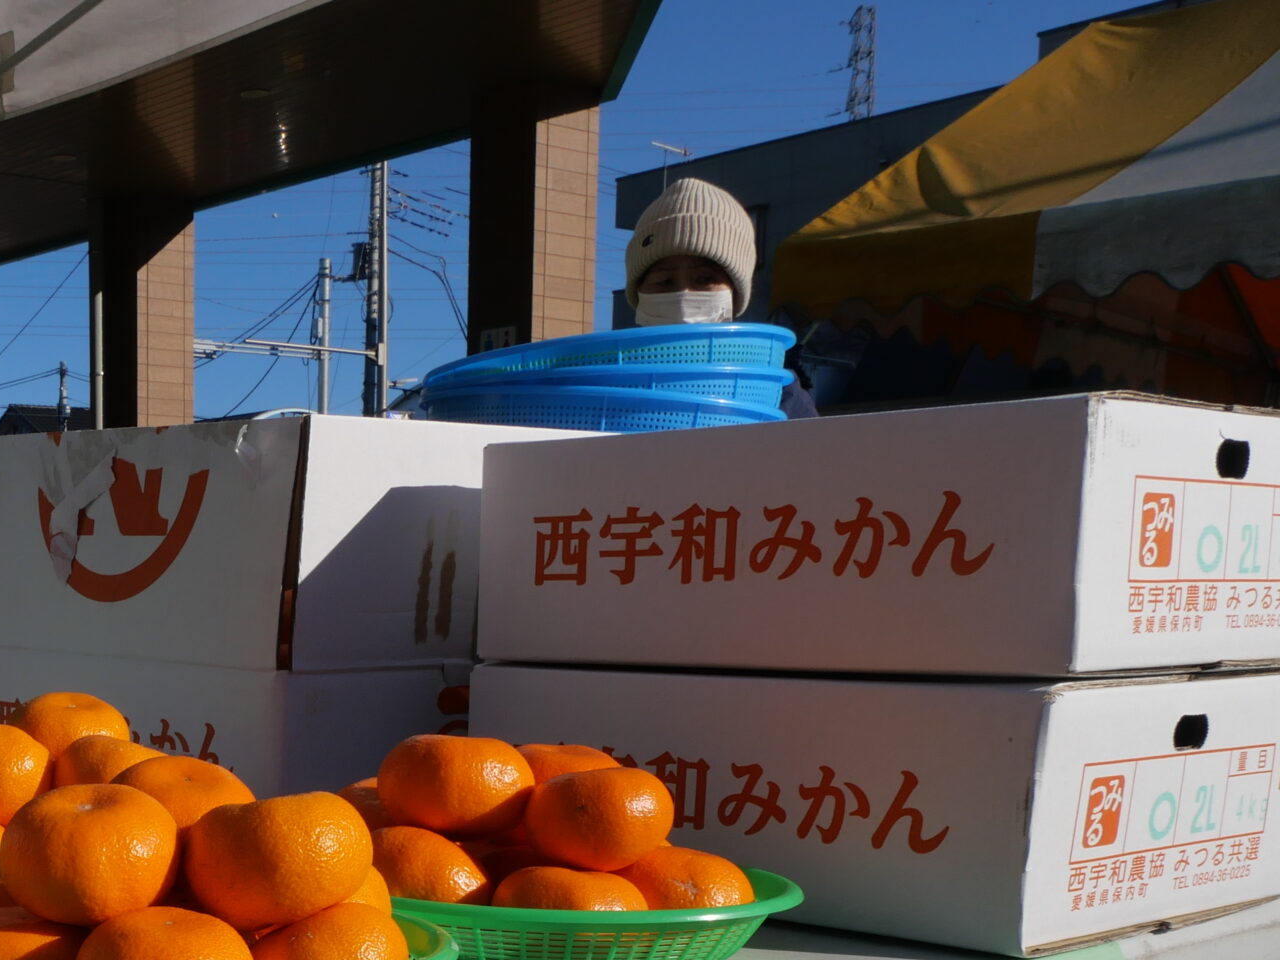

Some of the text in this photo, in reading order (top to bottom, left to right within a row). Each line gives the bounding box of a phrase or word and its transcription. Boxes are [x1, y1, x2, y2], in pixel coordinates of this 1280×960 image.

[533, 490, 995, 586] 西宇和みかん
[1237, 524, 1261, 574] 2L
[1128, 584, 1218, 613] 西宇和農協
[513, 742, 950, 854] 和みかん
[1190, 784, 1217, 835] 2L
[1067, 836, 1262, 893] 西宇和農協 みつる共選
[1172, 876, 1190, 890] TEL
